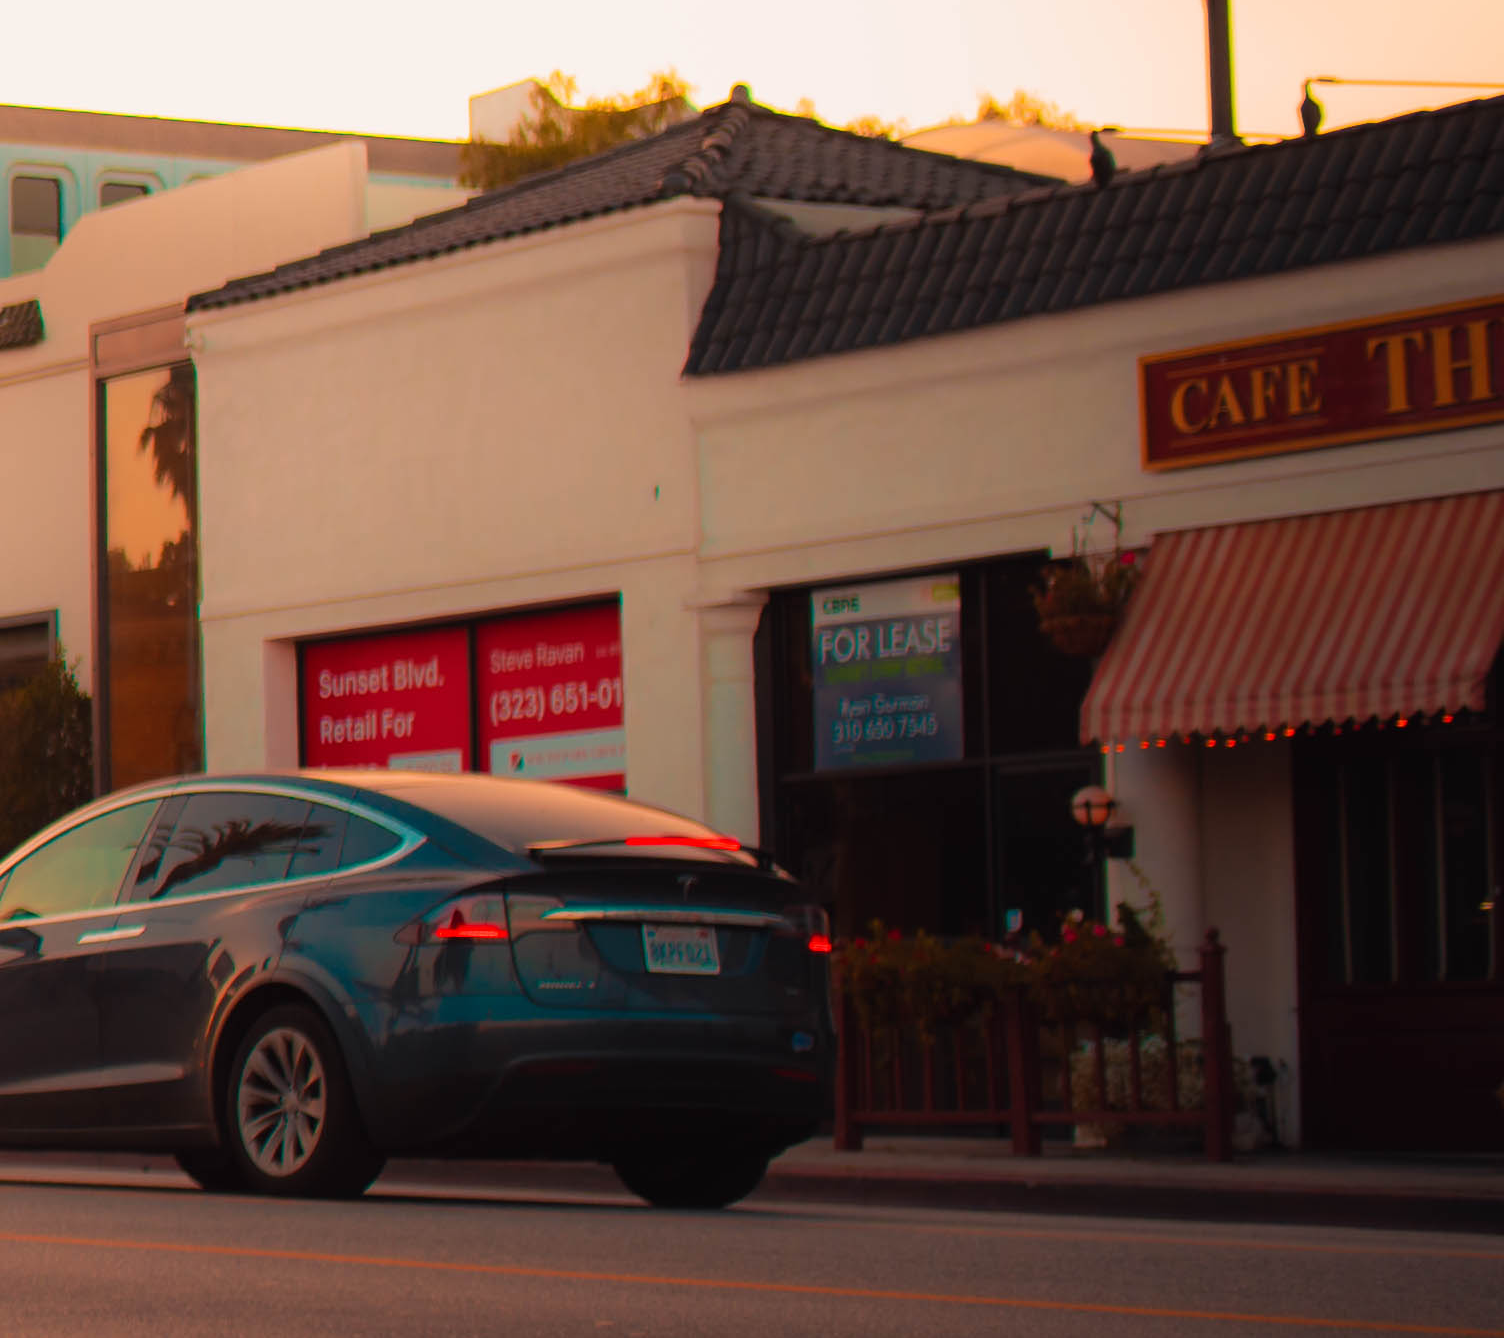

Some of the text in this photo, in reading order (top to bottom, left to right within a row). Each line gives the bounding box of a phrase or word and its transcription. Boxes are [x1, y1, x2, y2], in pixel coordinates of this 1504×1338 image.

[1170, 359, 1324, 435] CAFE
[490, 648, 534, 675] Steve
[535, 641, 585, 668] Ravan
[819, 618, 952, 665] FOR LEASE
[319, 655, 445, 699] Sunset Blvd.
[320, 707, 415, 745] Retail For
[490, 686, 546, 728] (323)
